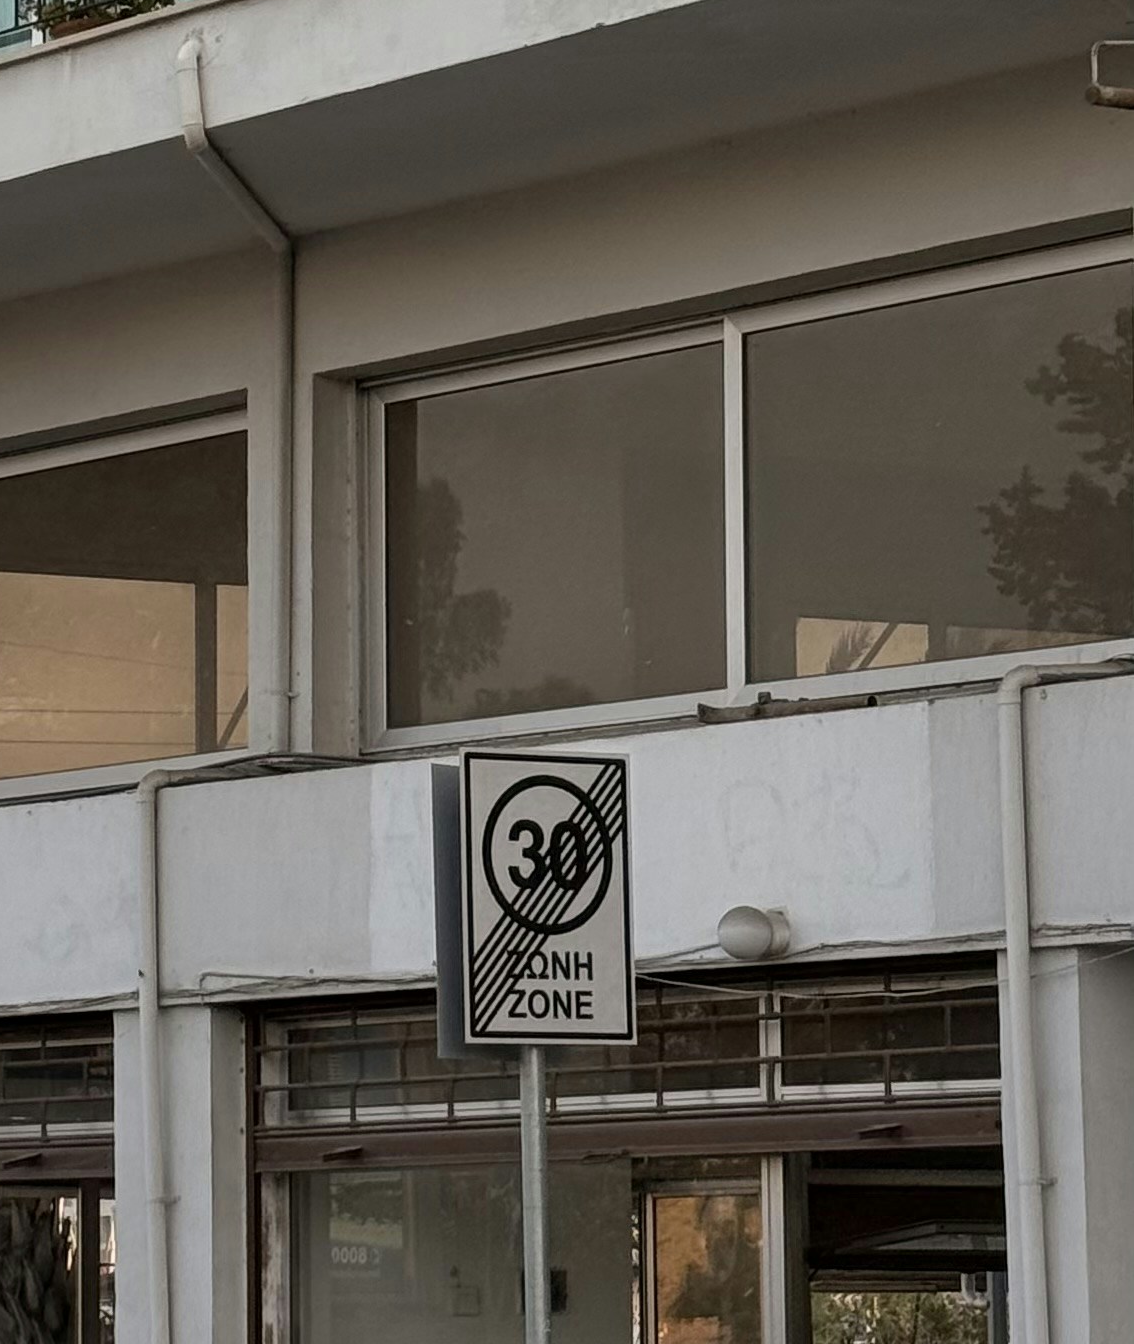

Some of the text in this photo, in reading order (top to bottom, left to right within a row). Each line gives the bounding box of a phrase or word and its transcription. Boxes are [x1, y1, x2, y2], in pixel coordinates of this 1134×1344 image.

[508, 819, 586, 890] 30
[507, 950, 593, 981] ΖΩΝΗ
[507, 989, 594, 1020] ZONE
